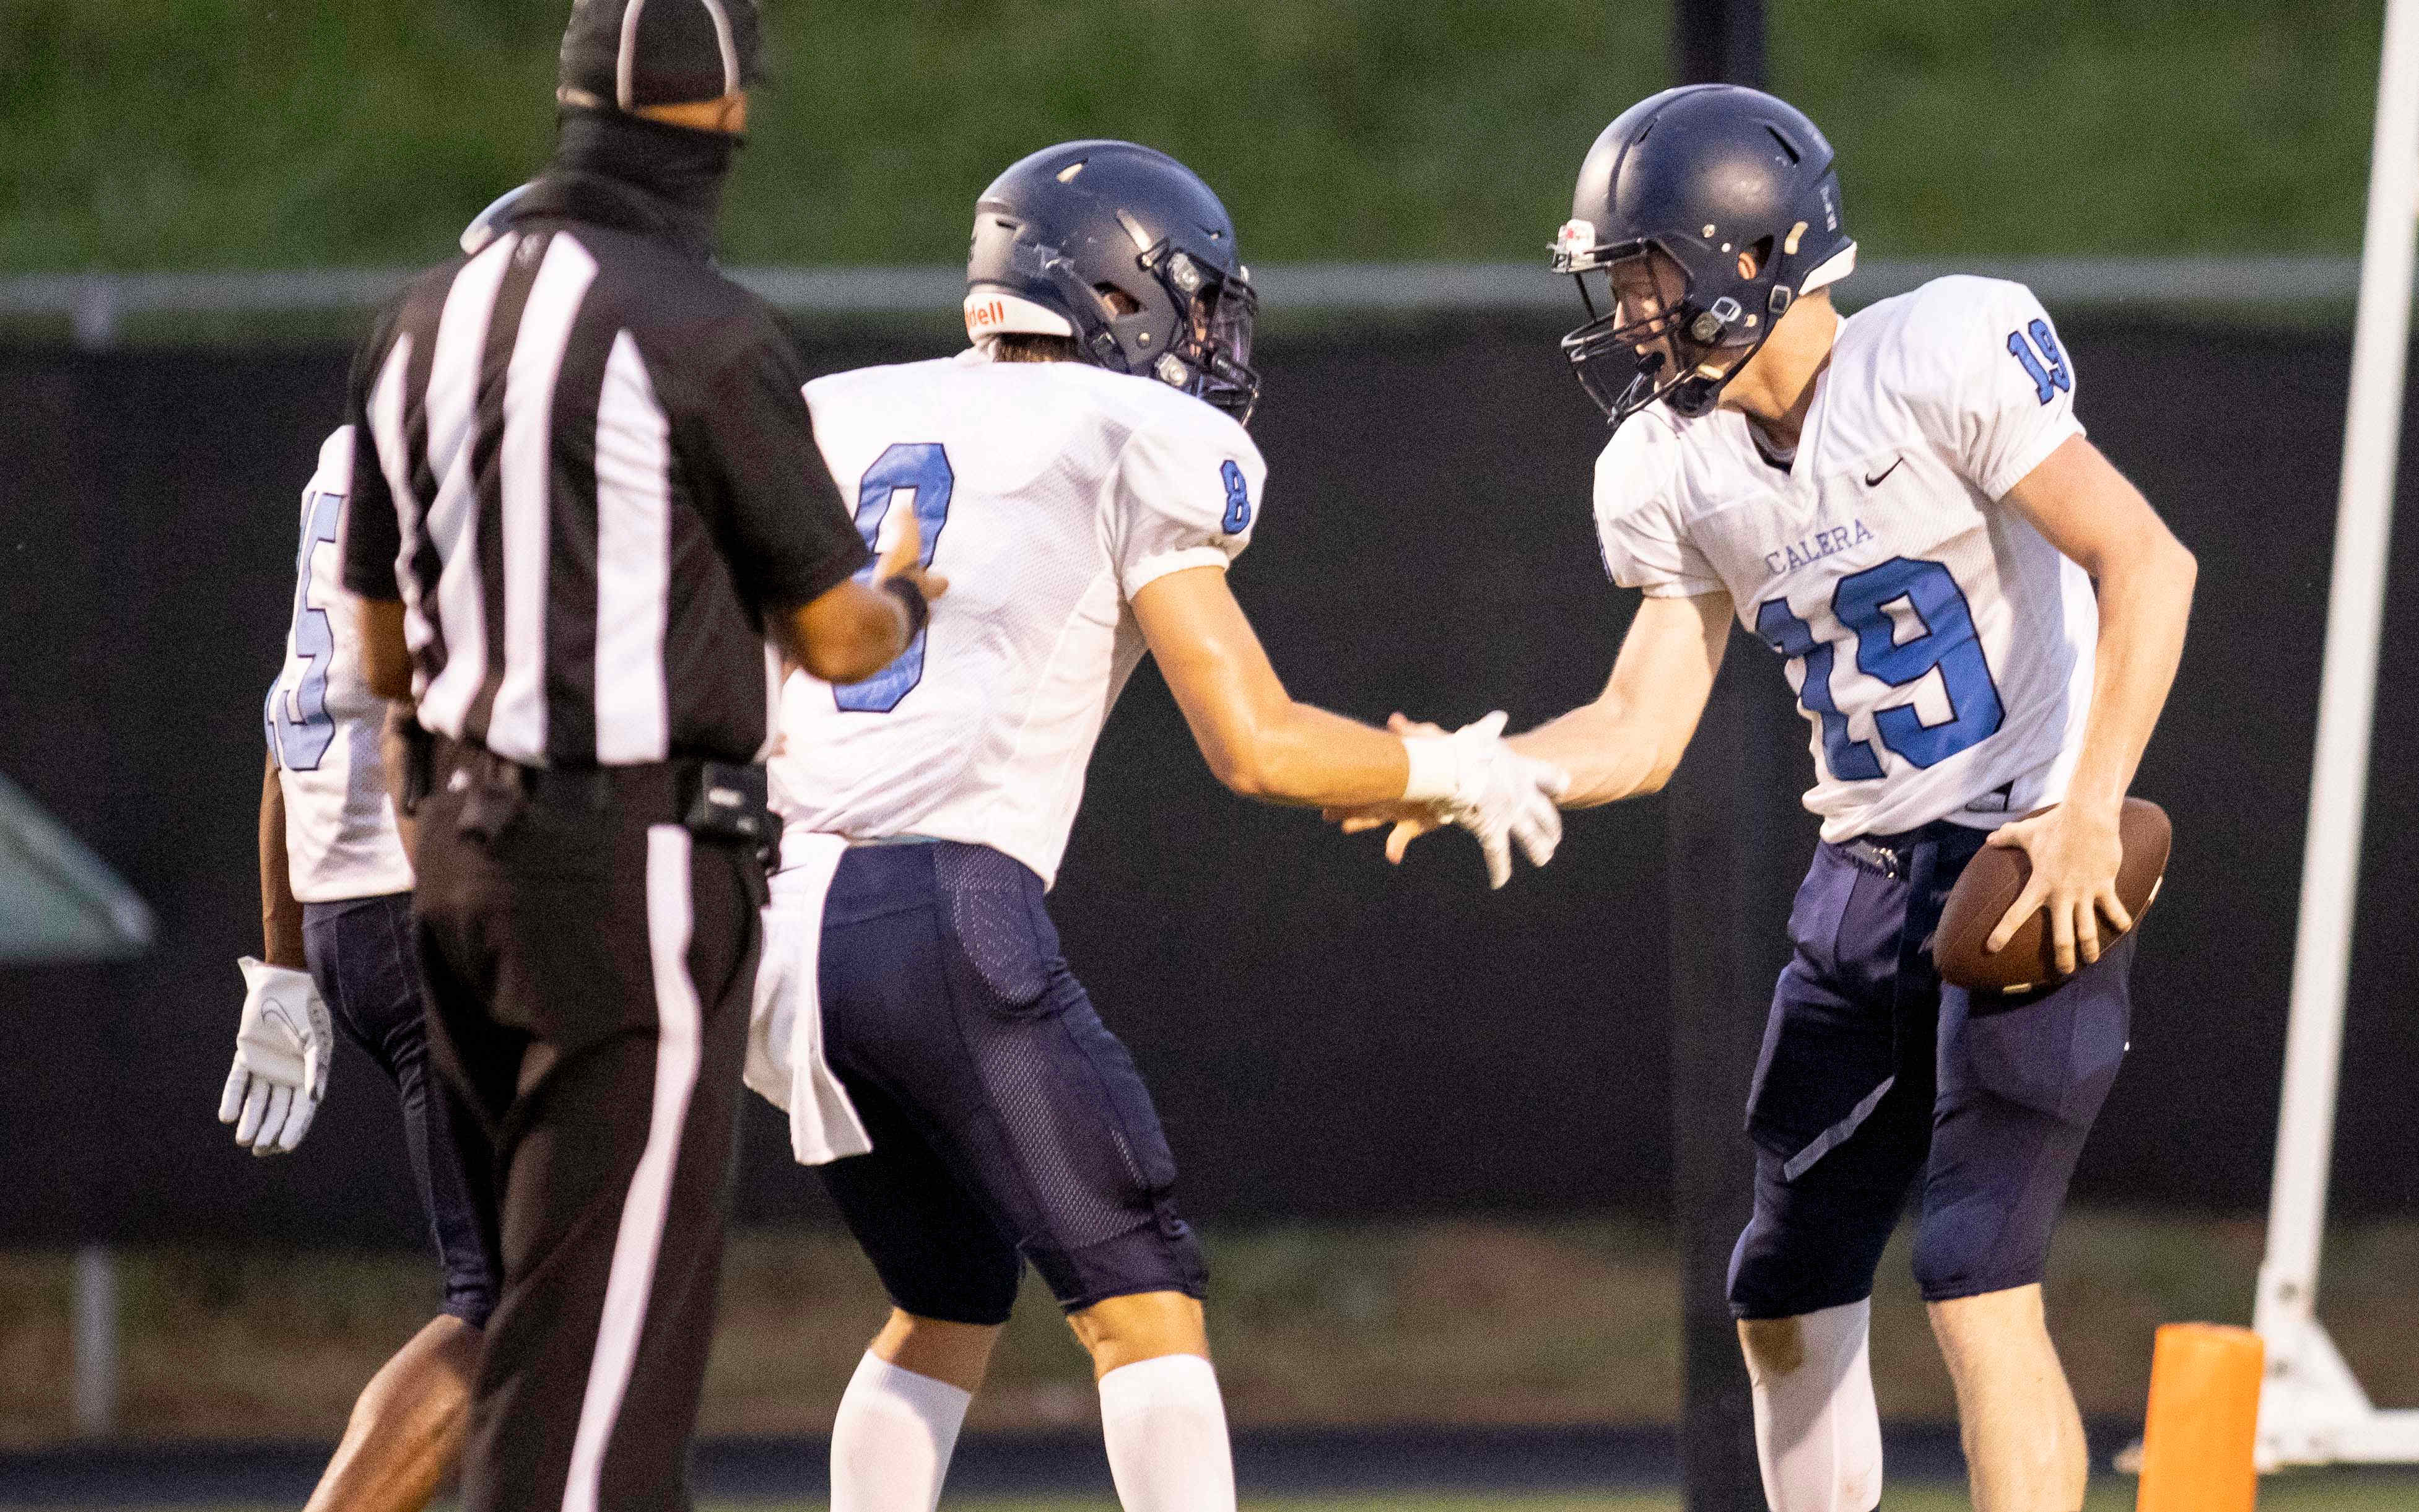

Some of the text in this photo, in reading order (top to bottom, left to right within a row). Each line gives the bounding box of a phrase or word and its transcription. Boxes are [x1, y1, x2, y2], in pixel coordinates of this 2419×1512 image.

[2007, 318, 2070, 406] 19
[1219, 459, 1251, 535] 8
[1766, 518, 1873, 575] CALERA
[1755, 556, 2006, 781] 19
